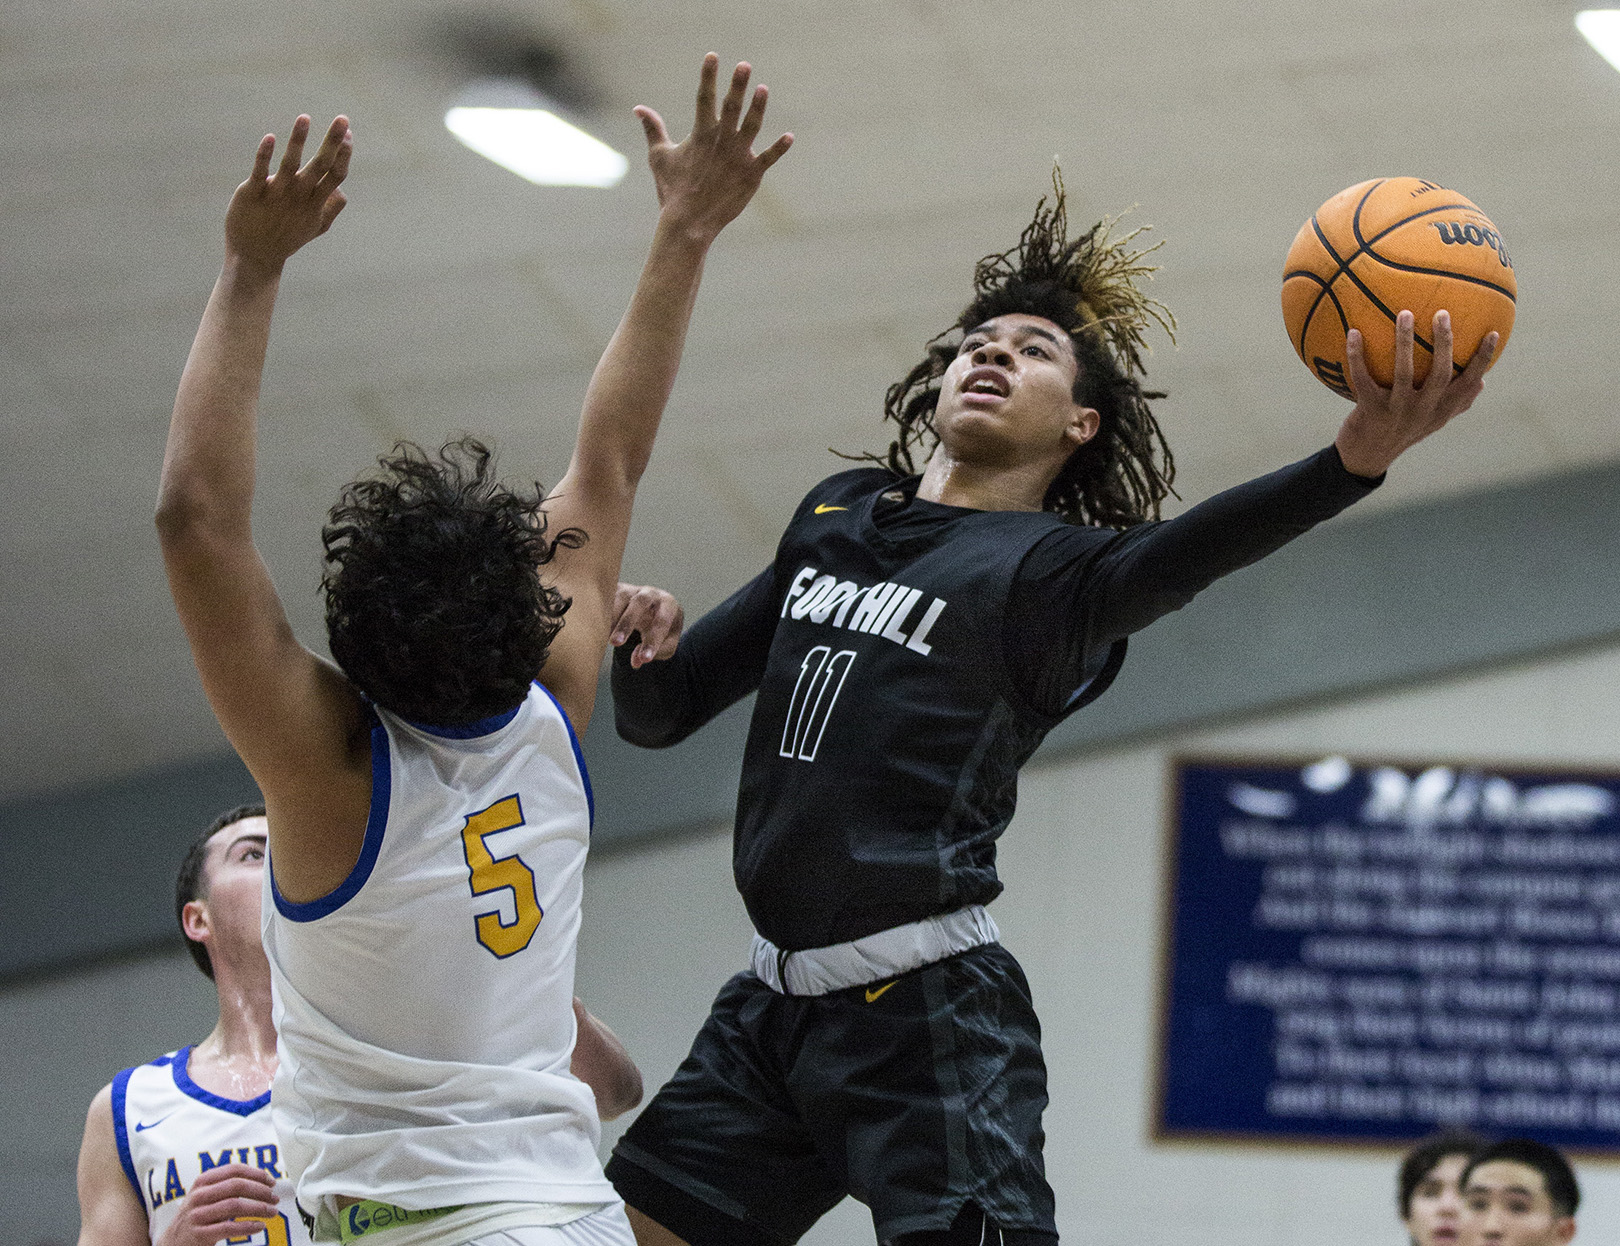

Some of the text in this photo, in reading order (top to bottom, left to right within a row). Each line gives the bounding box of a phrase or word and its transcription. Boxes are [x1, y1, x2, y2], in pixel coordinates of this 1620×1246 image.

[780, 565, 948, 657] FOOTHILL
[779, 645, 858, 763] 11
[460, 792, 544, 961] 5
[148, 1143, 289, 1210] LA MIR
